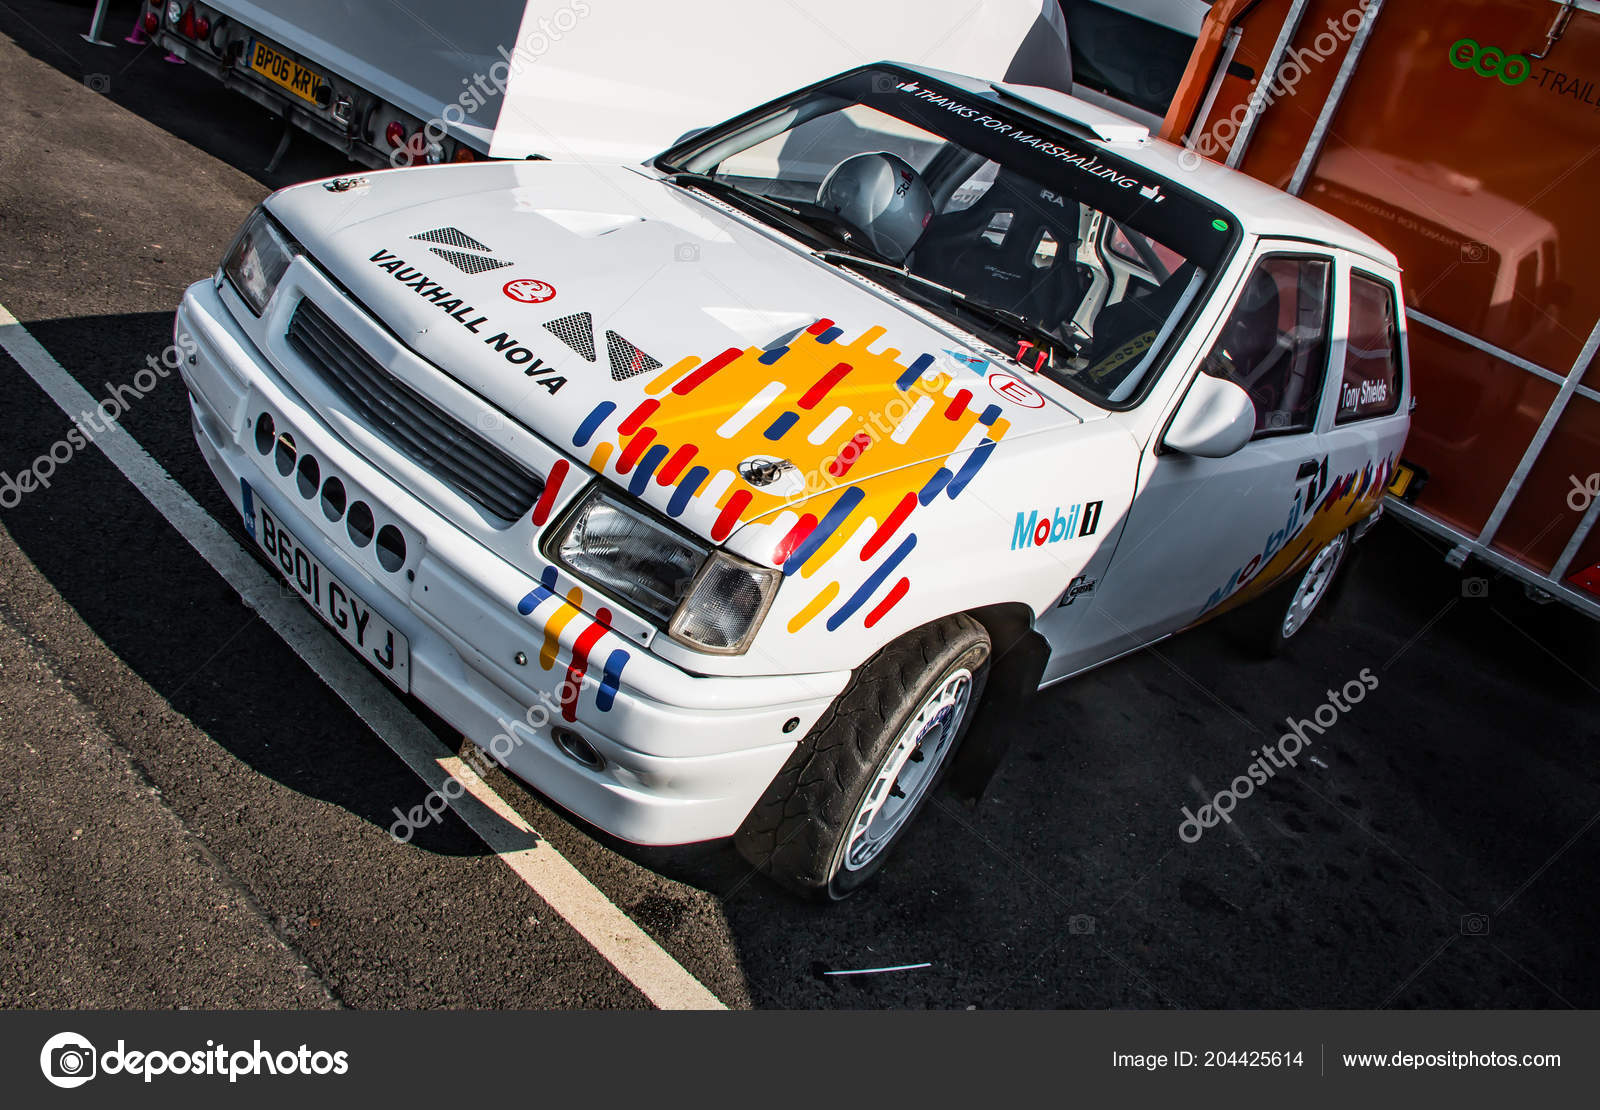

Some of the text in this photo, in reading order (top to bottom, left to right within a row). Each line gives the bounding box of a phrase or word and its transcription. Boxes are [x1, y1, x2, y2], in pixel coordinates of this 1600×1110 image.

[255, 44, 290, 81] BP06
[915, 89, 1139, 190] THANKS FOR MARSHALLING
[369, 248, 568, 396] VAUXHALL NOVA
[1341, 378, 1387, 412] Tony Shields
[261, 507, 321, 607] B601
[1010, 503, 1081, 551] Mobil
[1199, 496, 1303, 617] Mobil
